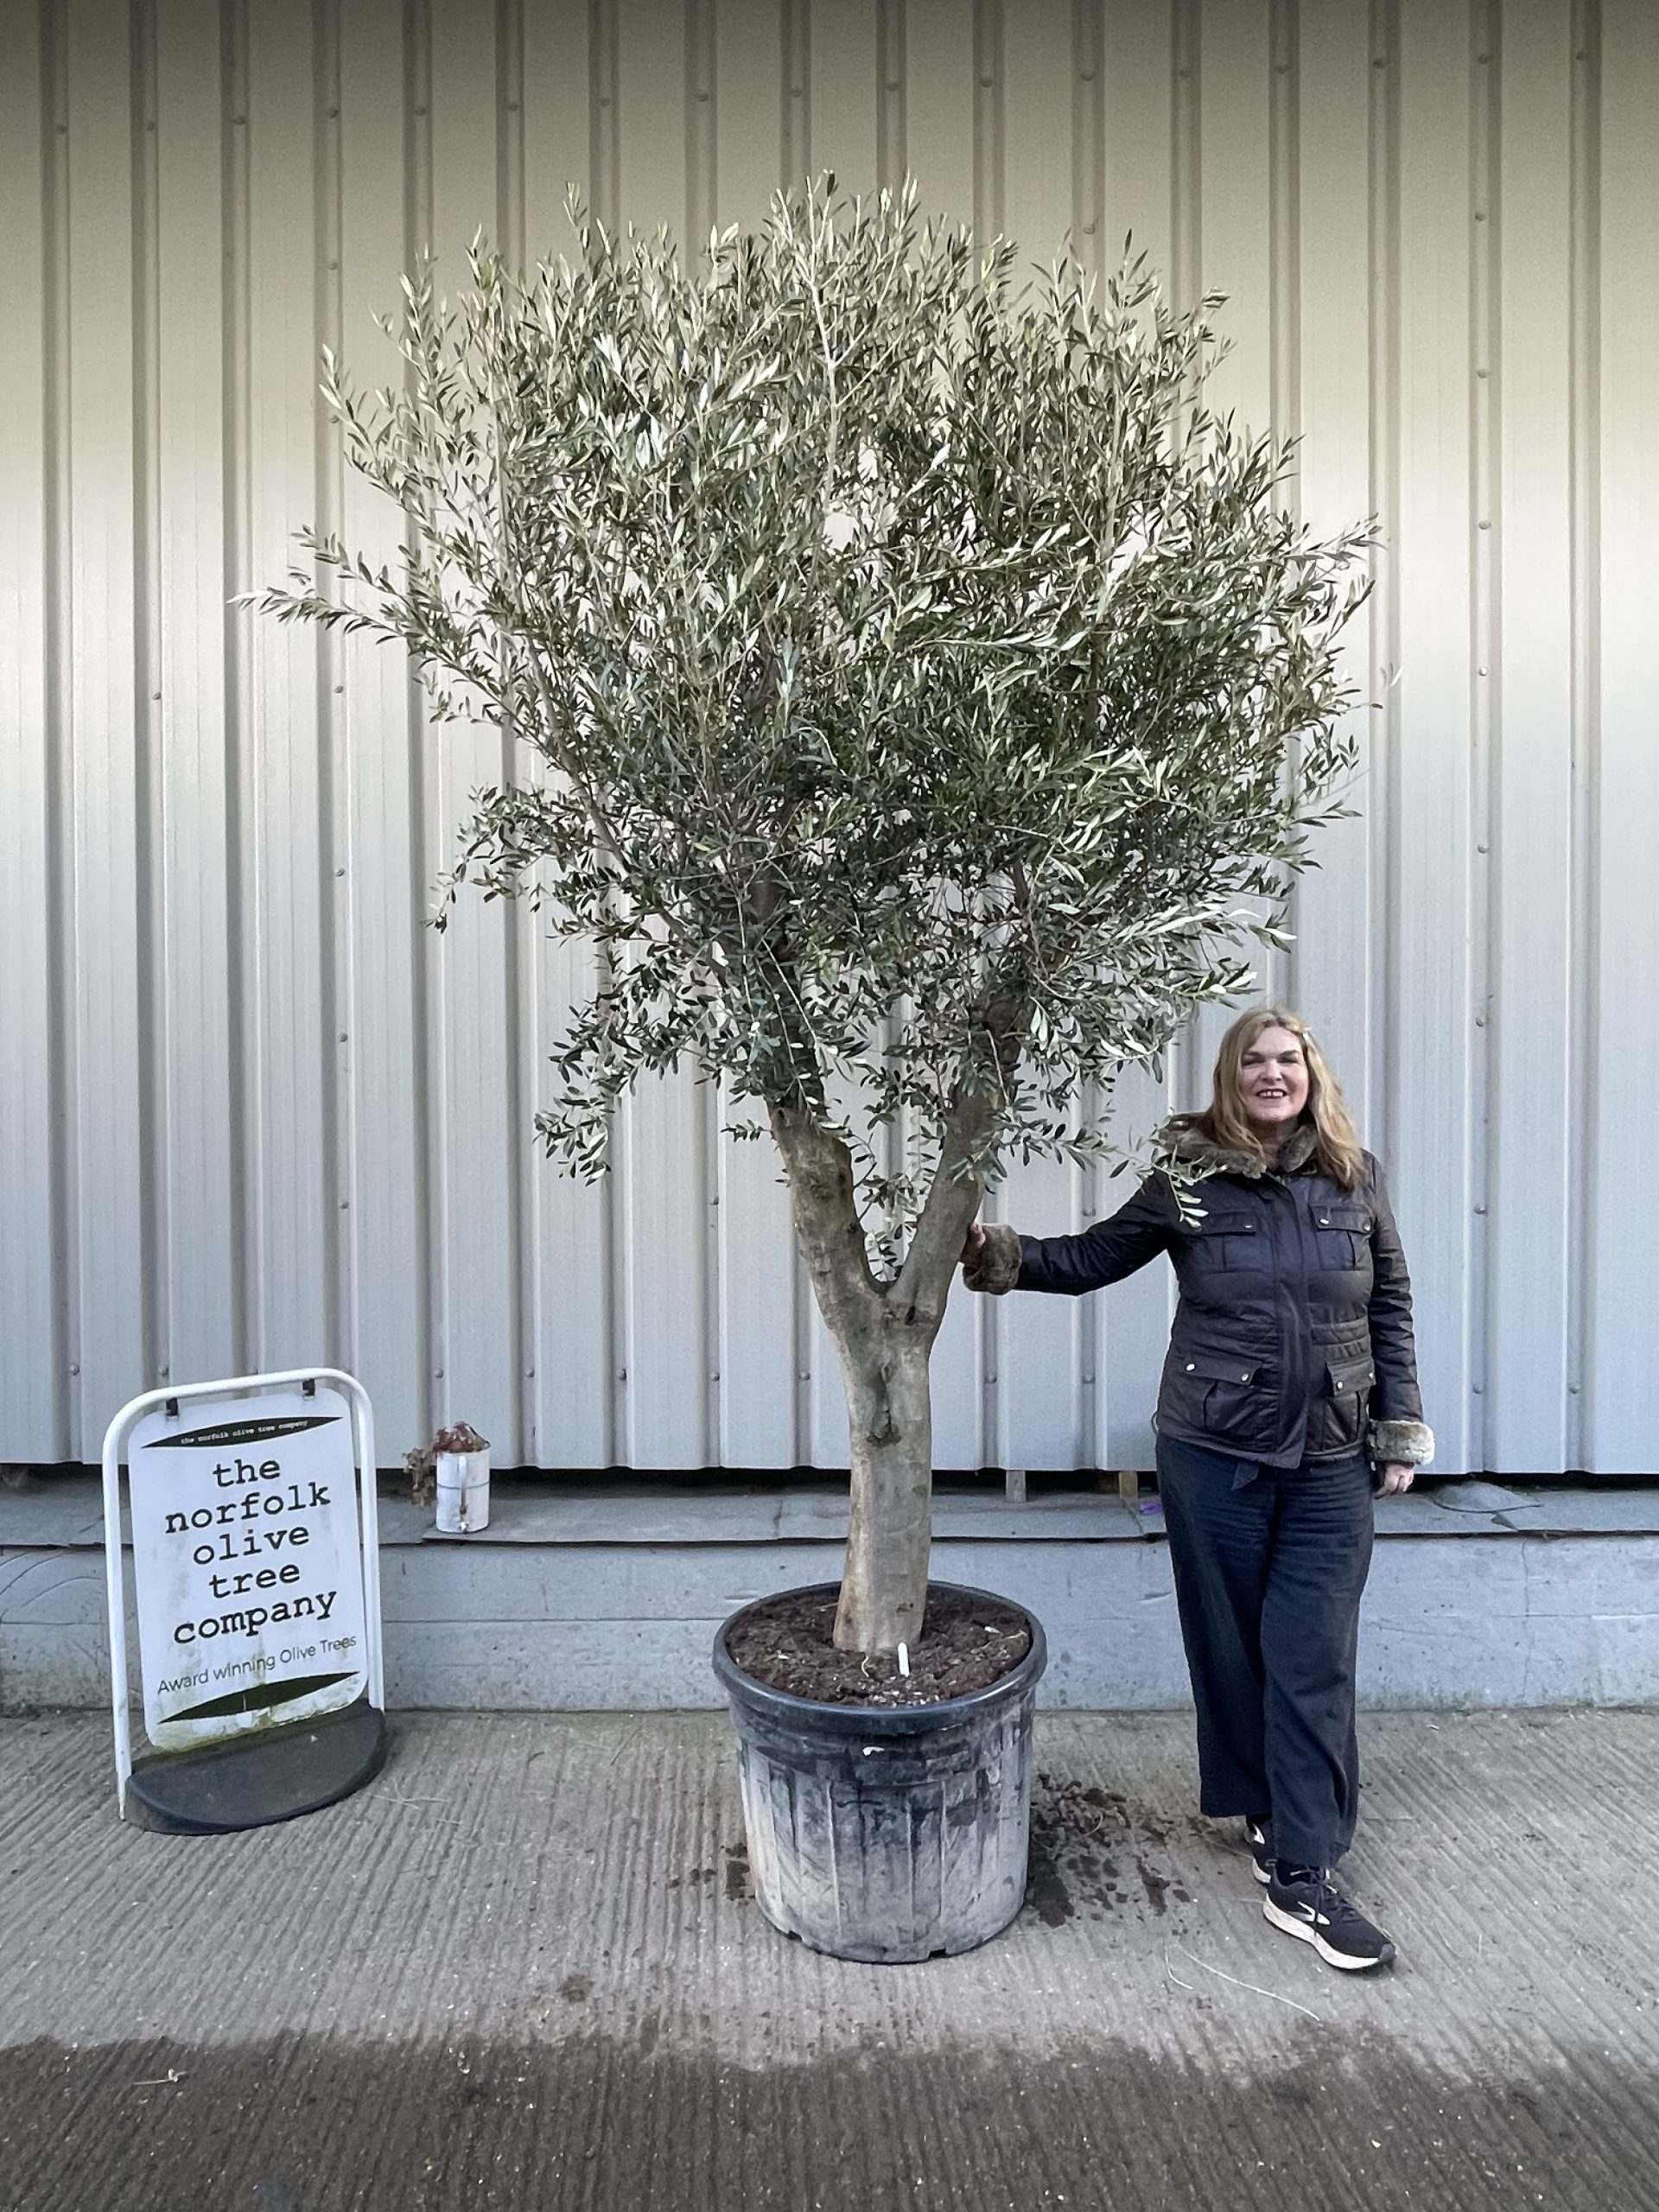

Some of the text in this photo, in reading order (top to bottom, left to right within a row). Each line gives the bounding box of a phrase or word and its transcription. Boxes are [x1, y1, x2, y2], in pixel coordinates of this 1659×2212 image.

[213, 1459, 281, 1488] the
[165, 1482, 330, 1535] norfolk
[192, 1526, 309, 1567] olive
[209, 1562, 301, 1599] tree
[174, 1591, 337, 1643] company
[157, 1669, 208, 1694] Award
[279, 1645, 316, 1663] Olive
[320, 1636, 357, 1653] Trees
